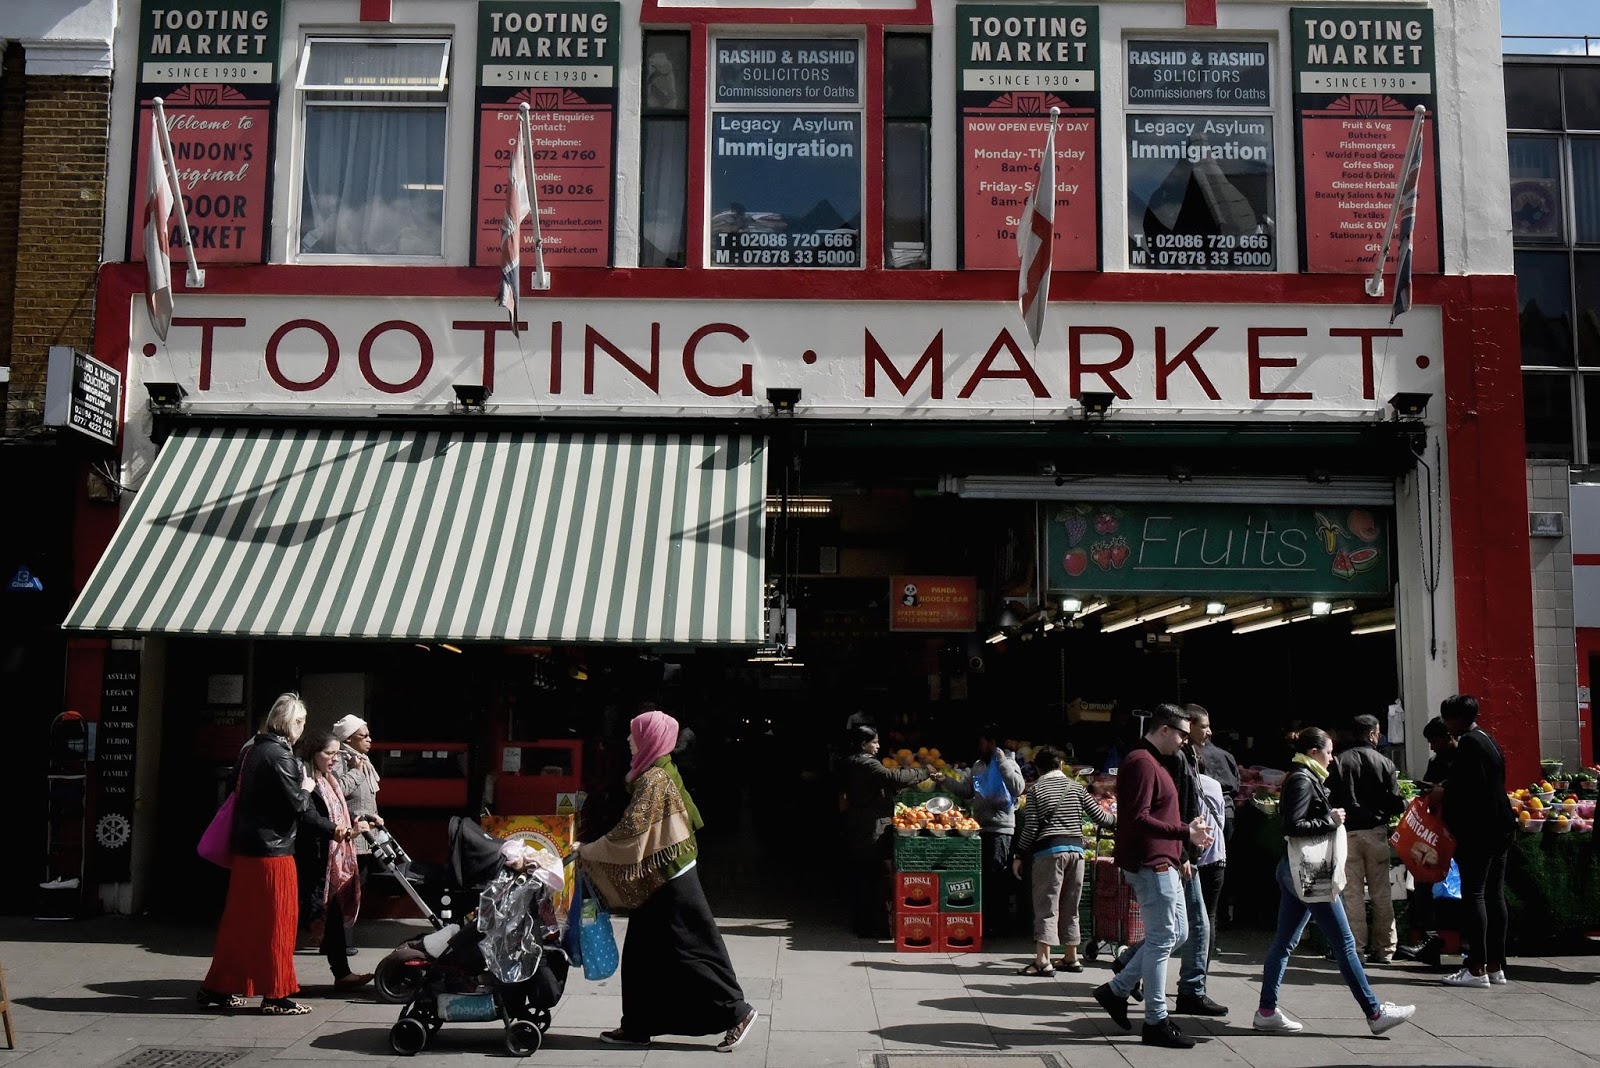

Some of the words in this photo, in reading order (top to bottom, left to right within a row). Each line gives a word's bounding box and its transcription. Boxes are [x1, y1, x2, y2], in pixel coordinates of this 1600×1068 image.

[152, 10, 268, 30] TOOTING
[490, 13, 608, 33] TOOTING
[969, 17, 1087, 37] TOOTING
[1305, 20, 1423, 41] TOOTING
[151, 34, 267, 55] MARKET
[490, 38, 607, 58] MARKET
[719, 50, 776, 64] RASHID
[782, 50, 793, 64] &
[797, 50, 855, 64] RASHID
[970, 42, 1087, 62] MARKET
[1129, 51, 1186, 65] RASHID
[1191, 52, 1203, 65] &
[1208, 52, 1265, 66] RASHID
[1307, 45, 1423, 65] MARKET
[168, 67, 208, 78] SINCE
[214, 67, 247, 78] 1930
[508, 71, 548, 81] SINCE
[555, 71, 587, 81] 1930
[743, 69, 830, 81] SOLICITORS
[1154, 70, 1240, 82] SOLICITORS
[989, 75, 1029, 86] SINCE
[1036, 75, 1068, 86] 1930
[1326, 78, 1367, 88] SINCE
[1373, 78, 1405, 88] 1930
[719, 86, 802, 97] Commissioners
[805, 86, 820, 97] for
[824, 86, 855, 97] Oaths
[1130, 87, 1213, 99] Commissioners
[1216, 87, 1231, 99] for
[1234, 88, 1266, 99] Oaths
[158, 114, 231, 131] Welcome
[238, 115, 253, 130] to
[497, 113, 513, 121] For
[553, 113, 594, 123] Enquiries
[721, 117, 781, 133] Legacy
[793, 118, 854, 134] Asylum
[969, 123, 996, 131] NOW
[998, 123, 1027, 131] OPEN
[1067, 123, 1089, 131] DAY
[1135, 120, 1195, 136] Legacy
[1203, 120, 1265, 136] Asylum
[1342, 121, 1363, 129] Fruit
[1366, 121, 1372, 129] &
[1375, 121, 1391, 131] Veg
[536, 138, 581, 147] Telephone:
[719, 138, 853, 160] Immigration
[1340, 141, 1396, 151] Fishmongers
[533, 150, 557, 160] 672
[562, 150, 596, 160] 4760
[1132, 140, 1267, 163] Immigration
[1325, 151, 1352, 159] World
[1354, 151, 1377, 159] Food
[1001, 163, 1060, 172] 8am-6m
[1343, 161, 1372, 169] Coffee
[1373, 161, 1394, 170] Shop
[167, 163, 249, 190] riginal
[1342, 171, 1364, 179] Food
[1366, 171, 1372, 179] &
[1374, 171, 1395, 179] Drink
[541, 185, 563, 195] 130
[568, 185, 593, 195] 026
[1332, 181, 1364, 189] Chinese
[1365, 181, 1398, 189] Herbalis
[1315, 191, 1345, 200] Beauty
[1347, 191, 1374, 199] Salons
[1376, 191, 1383, 199] &
[170, 195, 247, 218] DOOR
[1338, 201, 1392, 209] Haberdasher
[168, 225, 246, 249] ARKET
[741, 233, 787, 247] 02086
[792, 233, 820, 247] 720
[825, 233, 853, 247] 666
[1156, 234, 1203, 248] 02086
[1207, 235, 1236, 248] 720
[1240, 235, 1268, 248] 666
[1330, 232, 1373, 240] Stationary
[743, 250, 789, 264] 07878
[794, 250, 813, 264] 33
[818, 250, 855, 264] 5000
[1158, 252, 1206, 265] 07878
[1210, 252, 1229, 265] 33
[1233, 252, 1271, 266] 5000
[171, 316, 753, 398] TOOTING
[865, 326, 1403, 401] MARKET
[83, 372, 110, 393] SOLICITORS
[94, 367, 99, 377] &
[100, 369, 116, 386] RASHID
[85, 393, 106, 409] ASYLUM
[93, 413, 103, 424] 720
[1138, 516, 1308, 567] Fruits
[1405, 810, 1439, 846] FRUITCAKE
[949, 881, 971, 892] LECH
